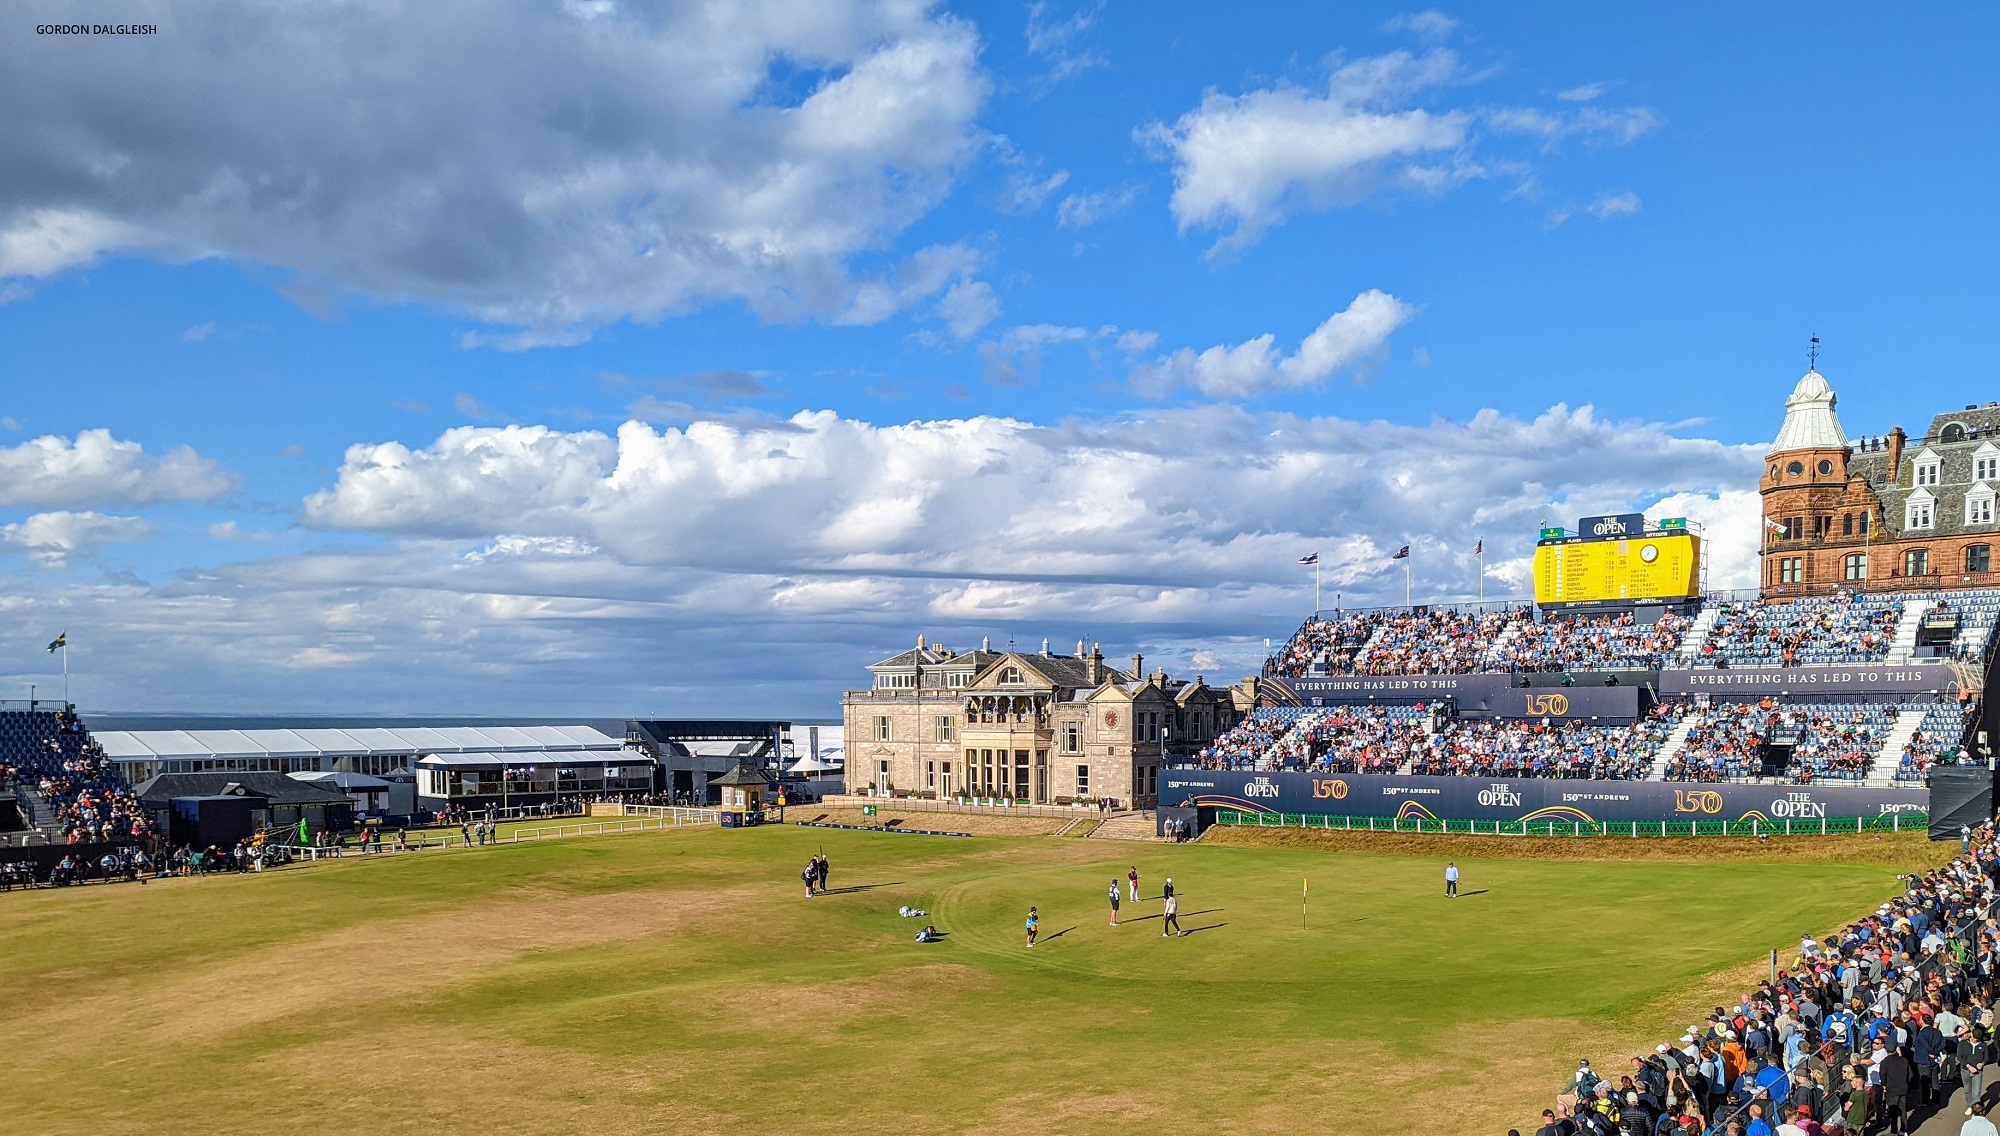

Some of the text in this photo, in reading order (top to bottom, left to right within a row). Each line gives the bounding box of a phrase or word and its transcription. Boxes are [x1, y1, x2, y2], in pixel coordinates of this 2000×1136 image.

[1593, 522, 1627, 535] OPEN
[1690, 671, 1923, 684] EVERYTHING HAS LED TO THIS
[1294, 680, 1457, 690] EVERYTHING HAS LED TO THIS
[1525, 693, 1569, 716] 150
[1254, 777, 1269, 785] THE
[1490, 783, 1509, 792] THE
[1244, 783, 1279, 797] OPEN
[1312, 779, 1348, 800] 150
[1477, 790, 1522, 806] OPEN
[1674, 789, 1723, 814] 150
[1787, 792, 1811, 802] THE
[1771, 799, 1826, 818] OPEN
